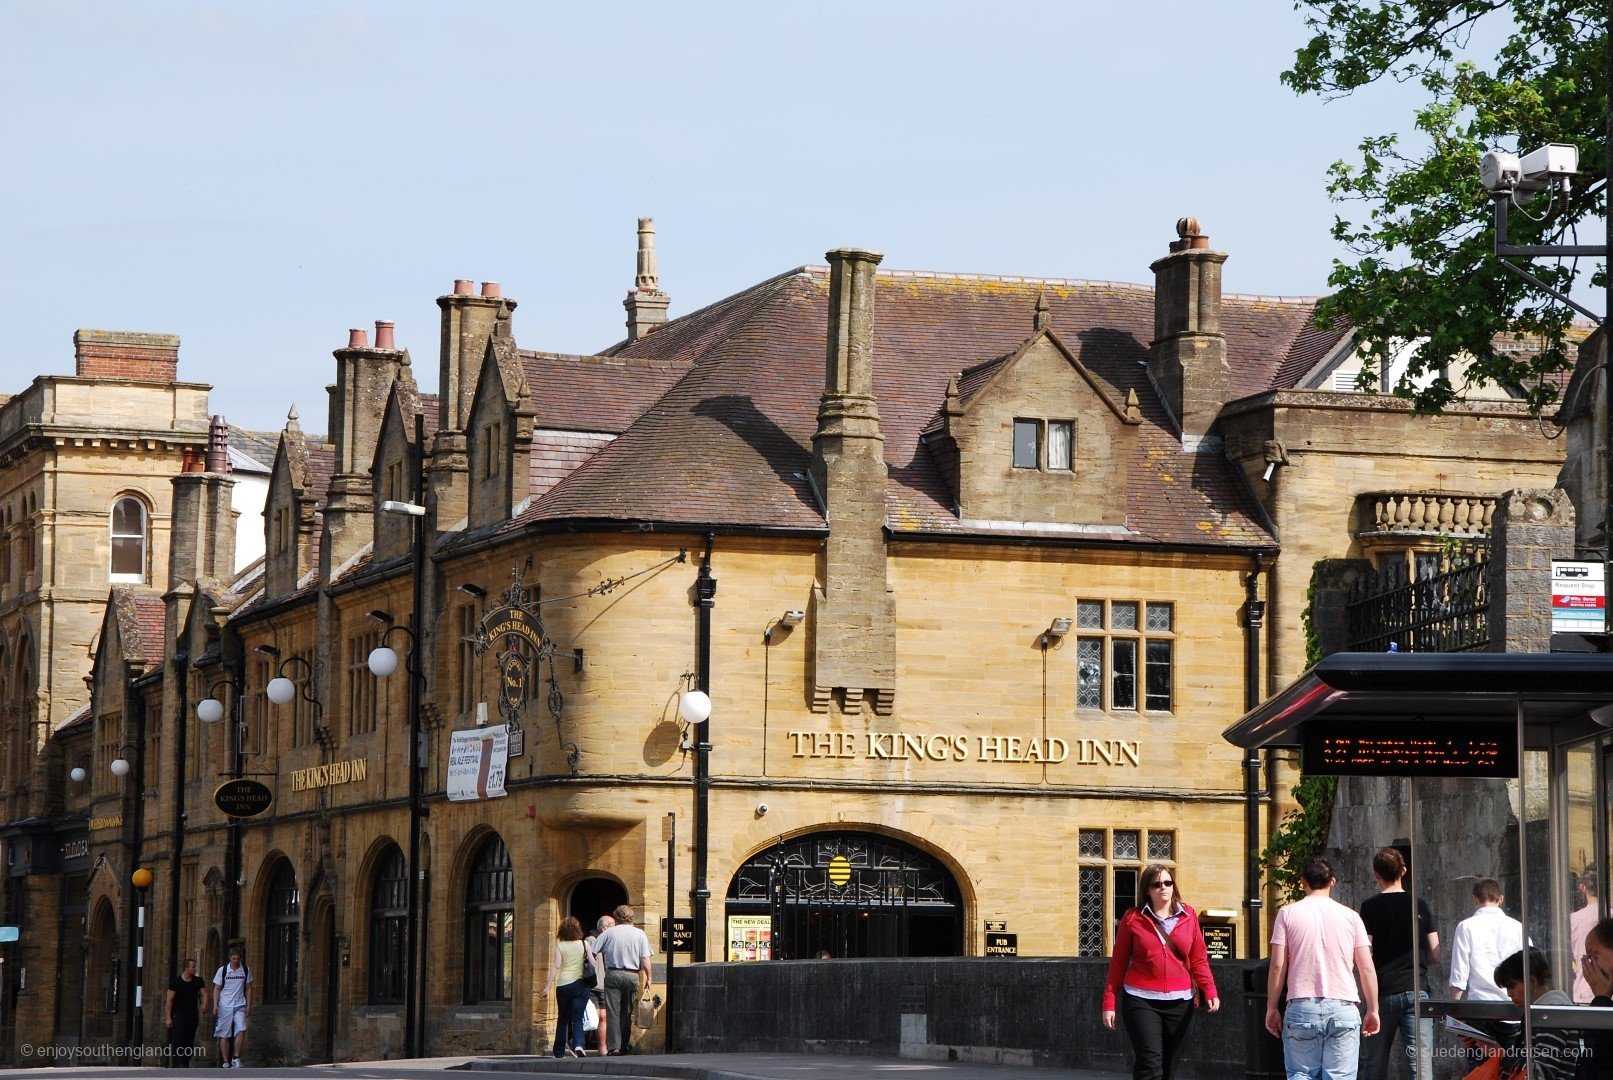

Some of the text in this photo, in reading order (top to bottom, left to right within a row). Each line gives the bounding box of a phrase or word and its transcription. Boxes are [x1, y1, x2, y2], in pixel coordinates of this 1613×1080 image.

[509, 609, 523, 621] THE
[488, 621, 541, 647] KING'S HEAD INN
[787, 731, 1143, 767] THE KING'S HEAD INN
[291, 757, 367, 791] THE KING'S HEAD INN
[987, 946, 1017, 954] ENTRANCE
[996, 938, 1008, 946] PUB
